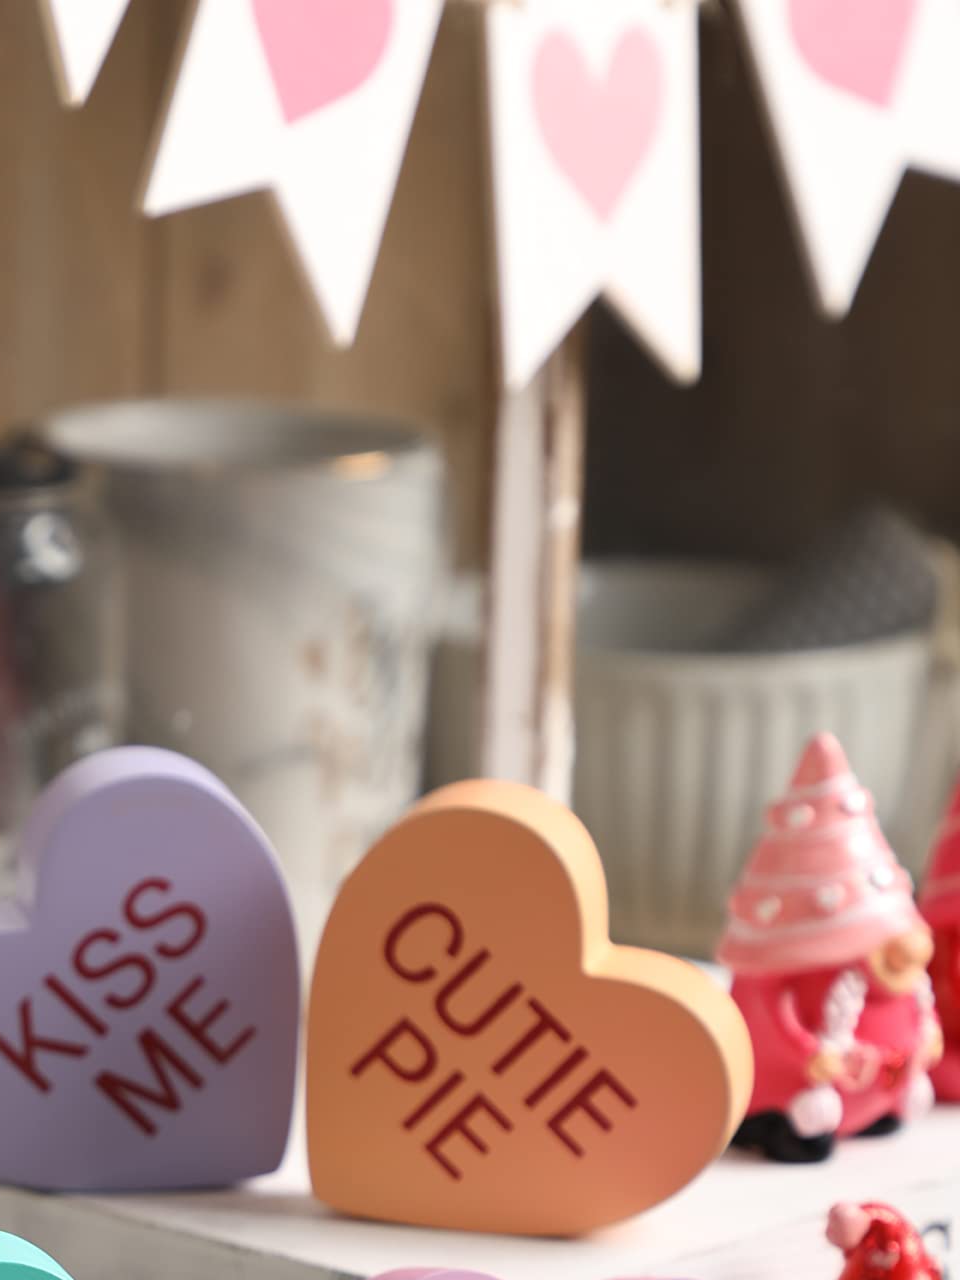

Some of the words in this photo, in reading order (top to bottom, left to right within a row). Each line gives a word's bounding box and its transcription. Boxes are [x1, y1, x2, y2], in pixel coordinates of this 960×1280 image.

[94, 977, 259, 1137] ME
[350, 1017, 513, 1181] PIE
[382, 901, 638, 1158] CUTIE
